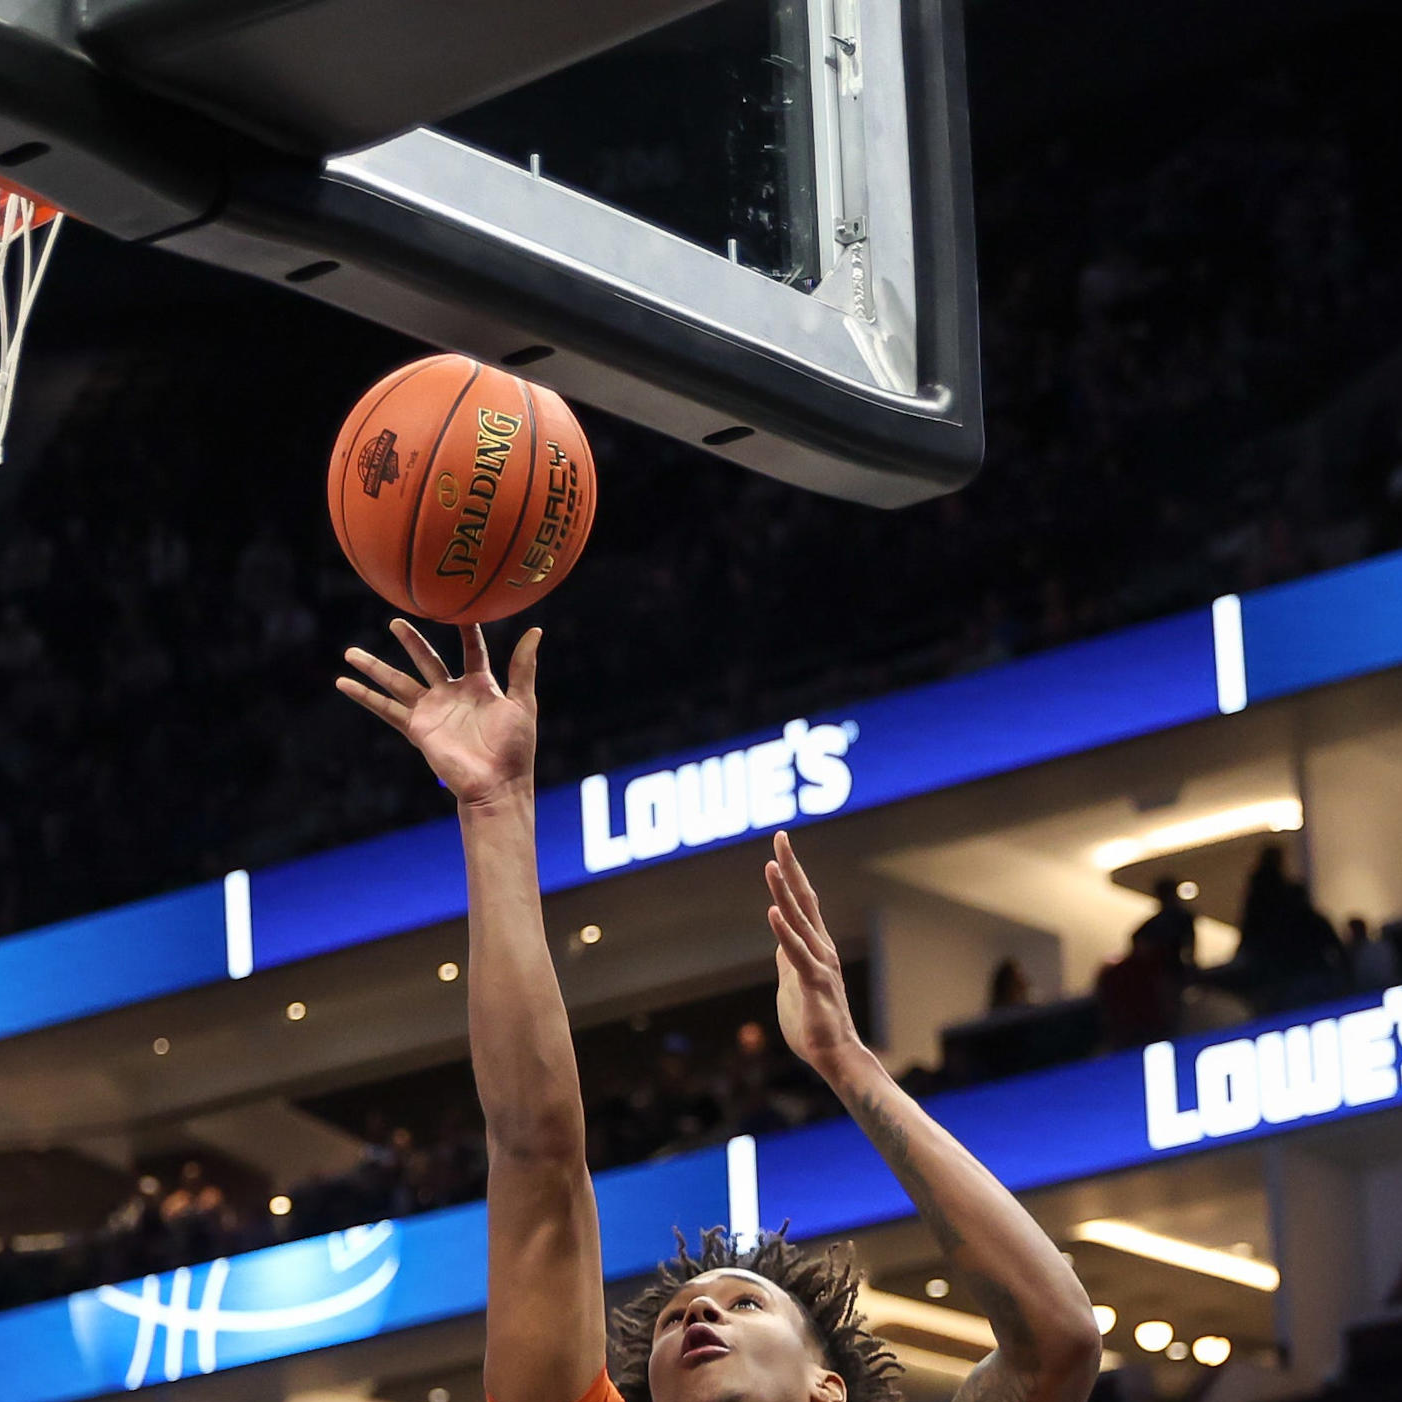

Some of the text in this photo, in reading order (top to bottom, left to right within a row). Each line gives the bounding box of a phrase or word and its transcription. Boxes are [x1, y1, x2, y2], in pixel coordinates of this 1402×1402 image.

[436, 407, 523, 585] SPALDING
[506, 440, 568, 590] LEGACY
[581, 718, 854, 873] LOWE'S
